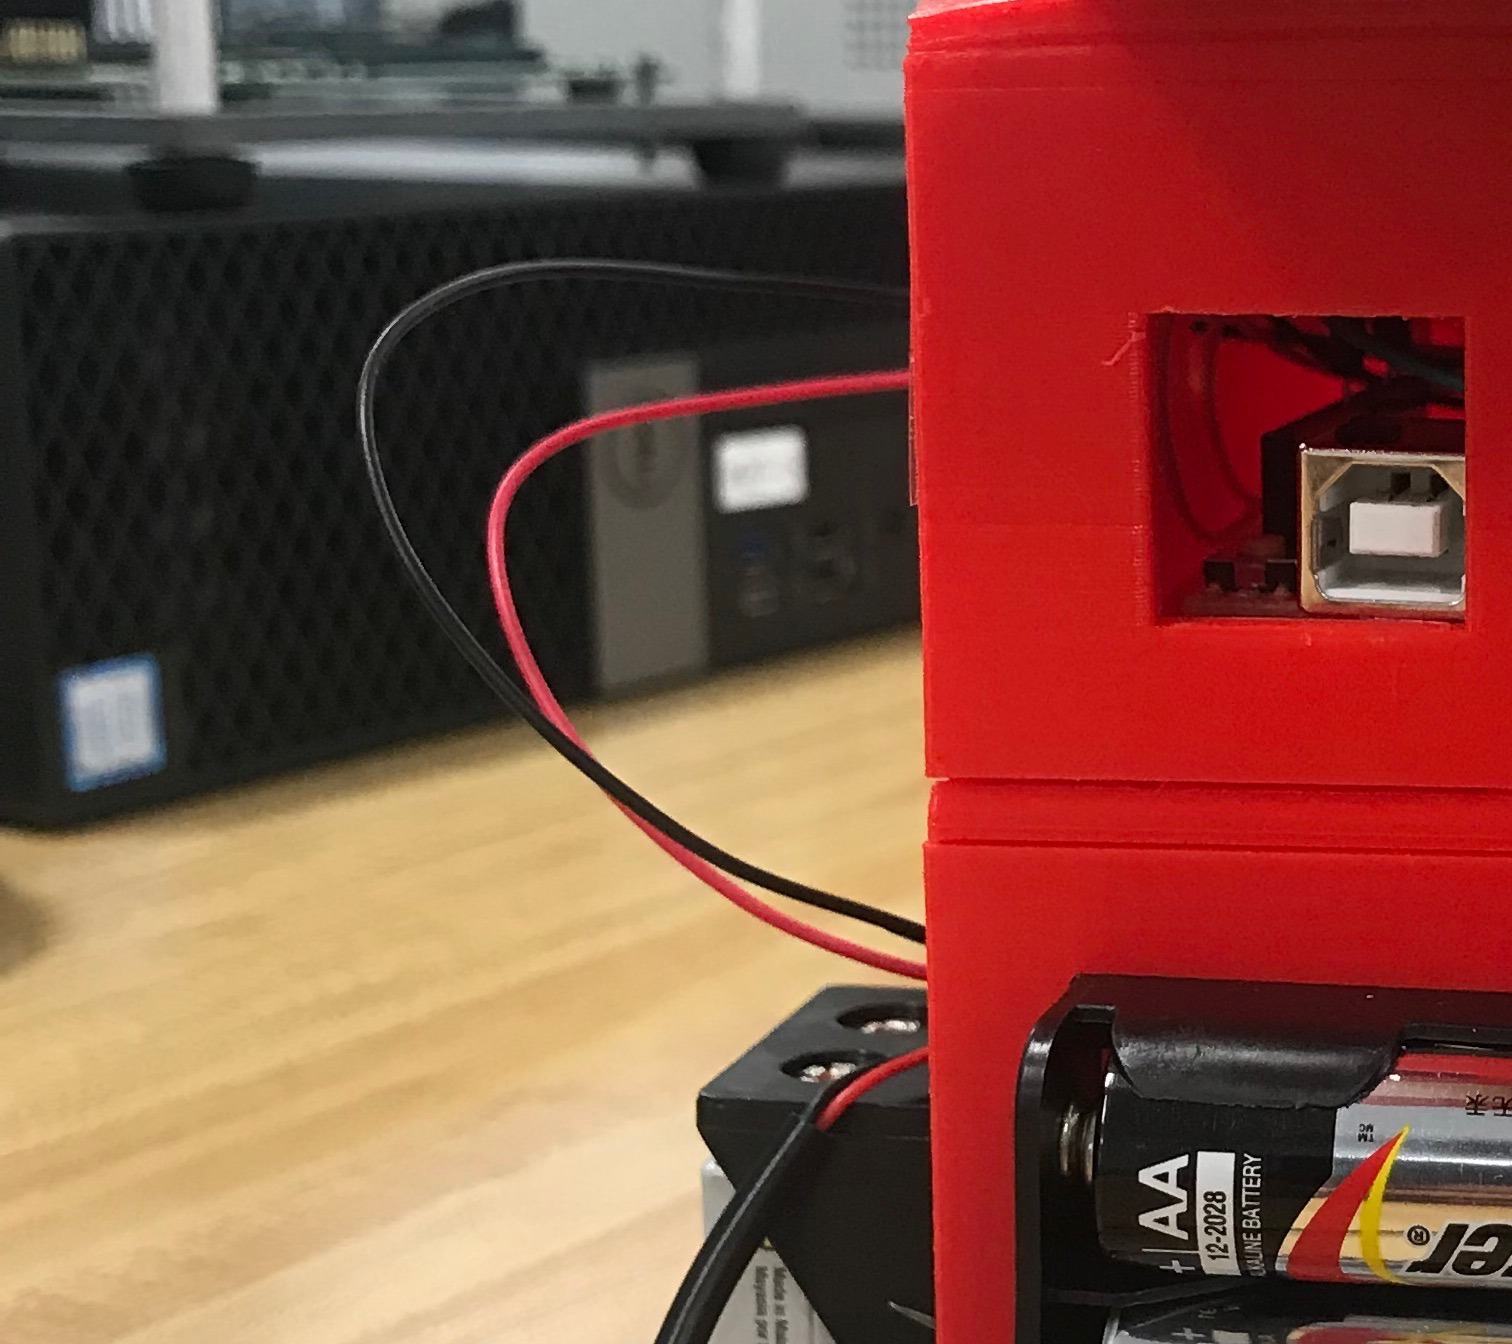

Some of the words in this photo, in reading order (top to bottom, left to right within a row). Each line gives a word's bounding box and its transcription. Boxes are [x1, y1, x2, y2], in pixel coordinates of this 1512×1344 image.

[1137, 1153, 1190, 1241] AA
[1203, 1190, 1231, 1261] 12-2028
[1241, 1152, 1263, 1230] BATTERY
